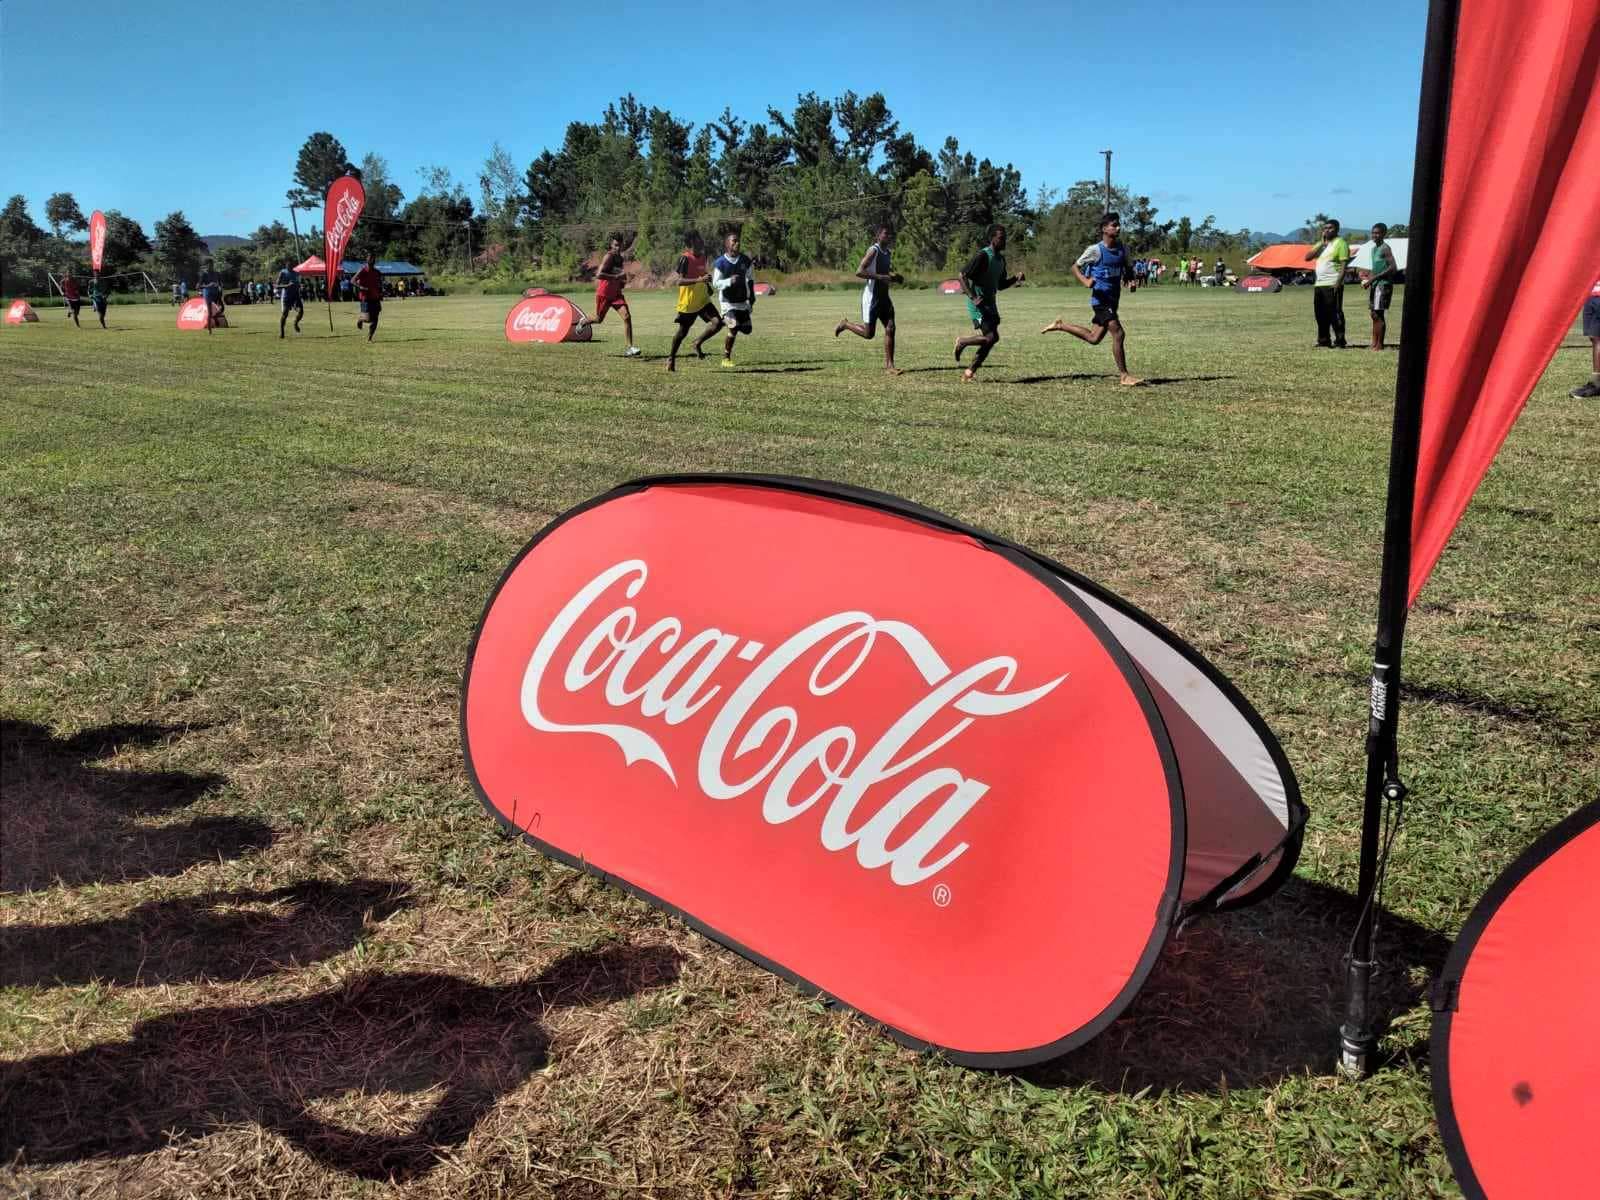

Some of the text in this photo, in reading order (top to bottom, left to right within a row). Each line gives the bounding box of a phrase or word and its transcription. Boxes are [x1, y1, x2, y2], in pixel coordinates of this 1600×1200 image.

[327, 187, 360, 252] Coca-Cola
[512, 306, 565, 332] Coca-Cola
[520, 559, 1070, 887] Coca-Cola
